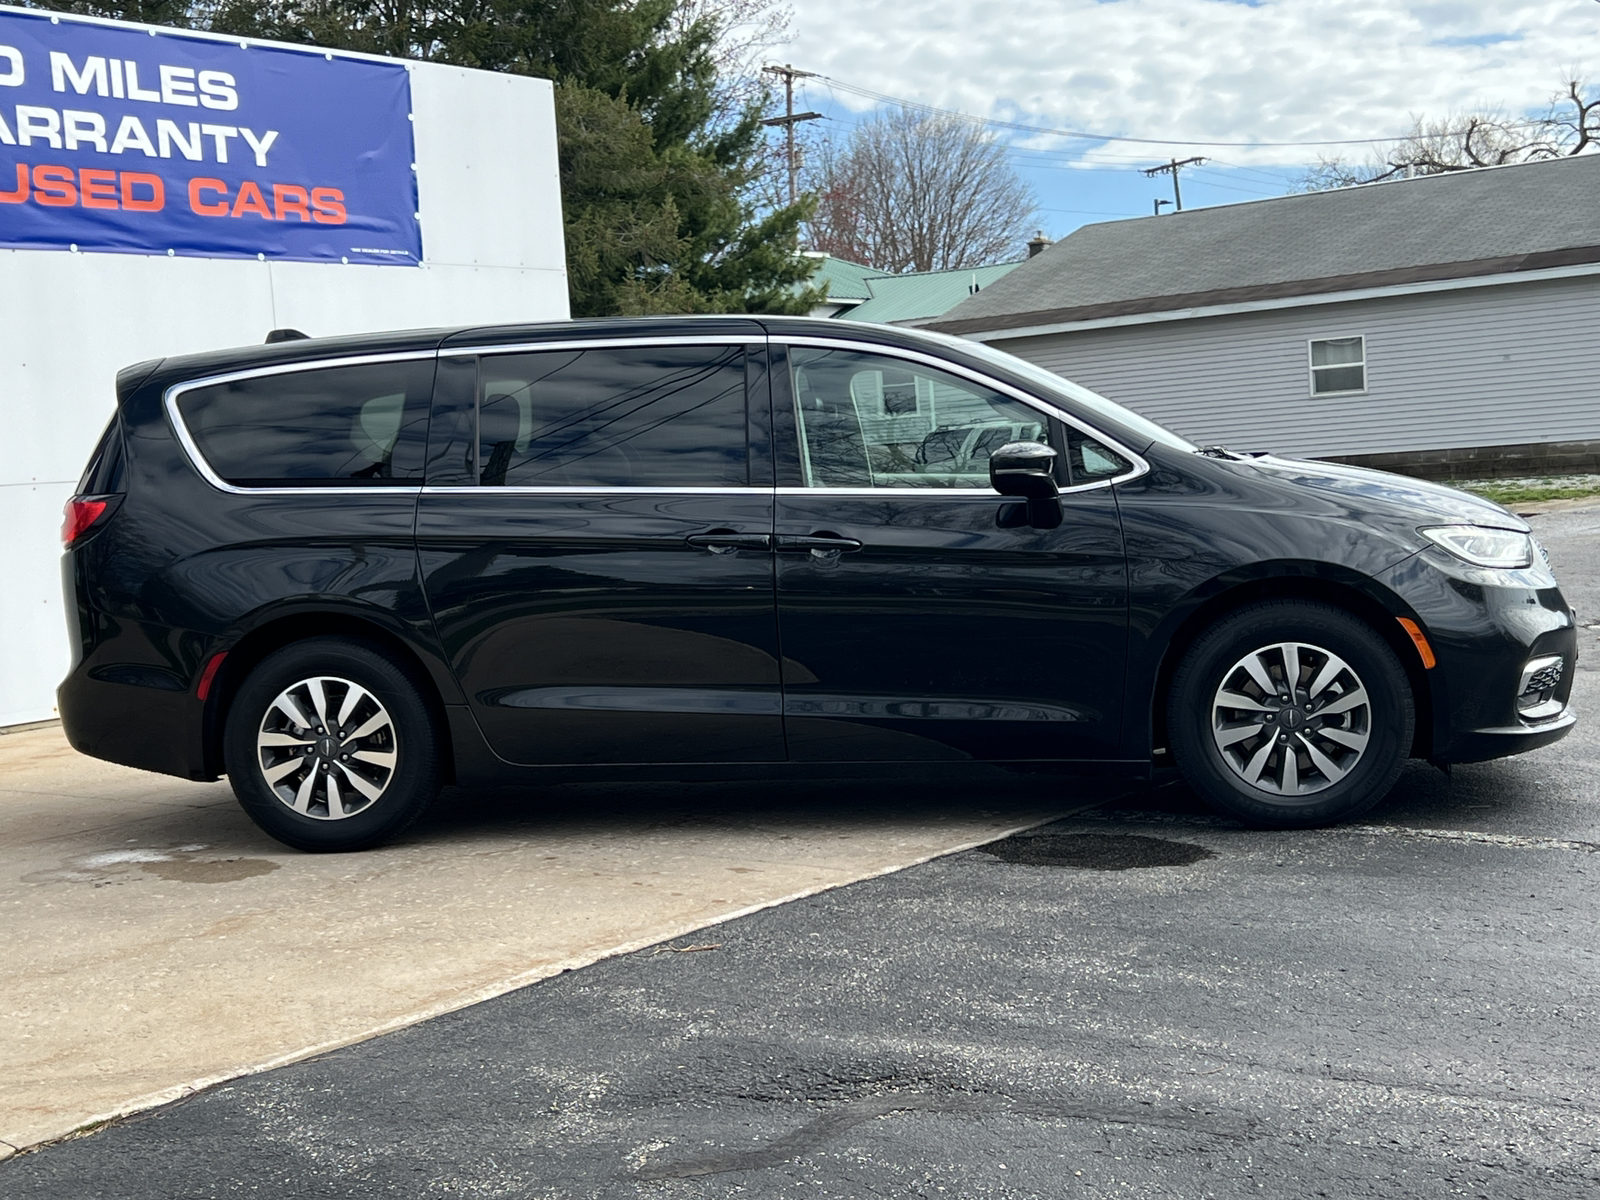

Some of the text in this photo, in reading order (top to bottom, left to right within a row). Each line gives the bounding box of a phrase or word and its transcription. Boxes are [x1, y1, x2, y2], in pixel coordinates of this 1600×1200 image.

[49, 51, 239, 111] MILES
[0, 163, 347, 225] USED CARS
